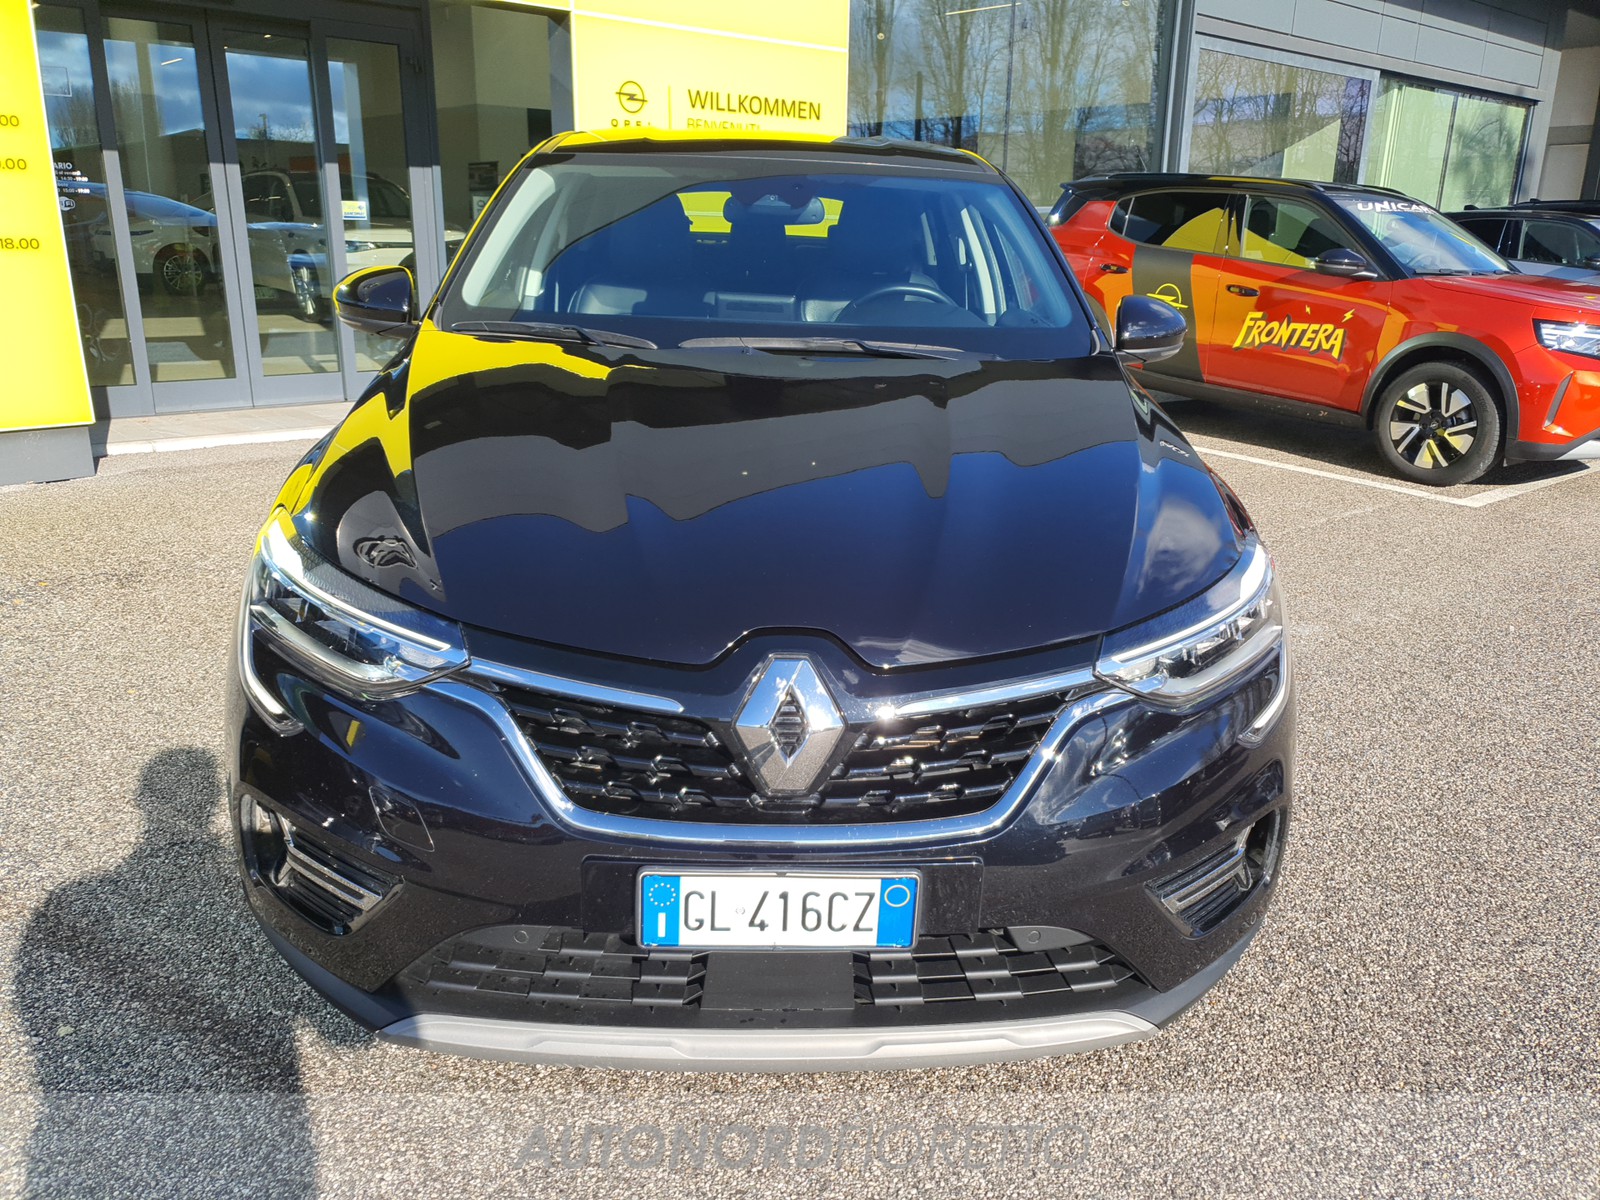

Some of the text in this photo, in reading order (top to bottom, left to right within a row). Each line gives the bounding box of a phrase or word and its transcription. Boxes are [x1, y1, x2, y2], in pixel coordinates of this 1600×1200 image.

[687, 89, 821, 121] WILLKOMMEN
[1232, 311, 1347, 361] FRONTERA
[683, 890, 731, 932] GL
[748, 890, 876, 932] 416CZ
